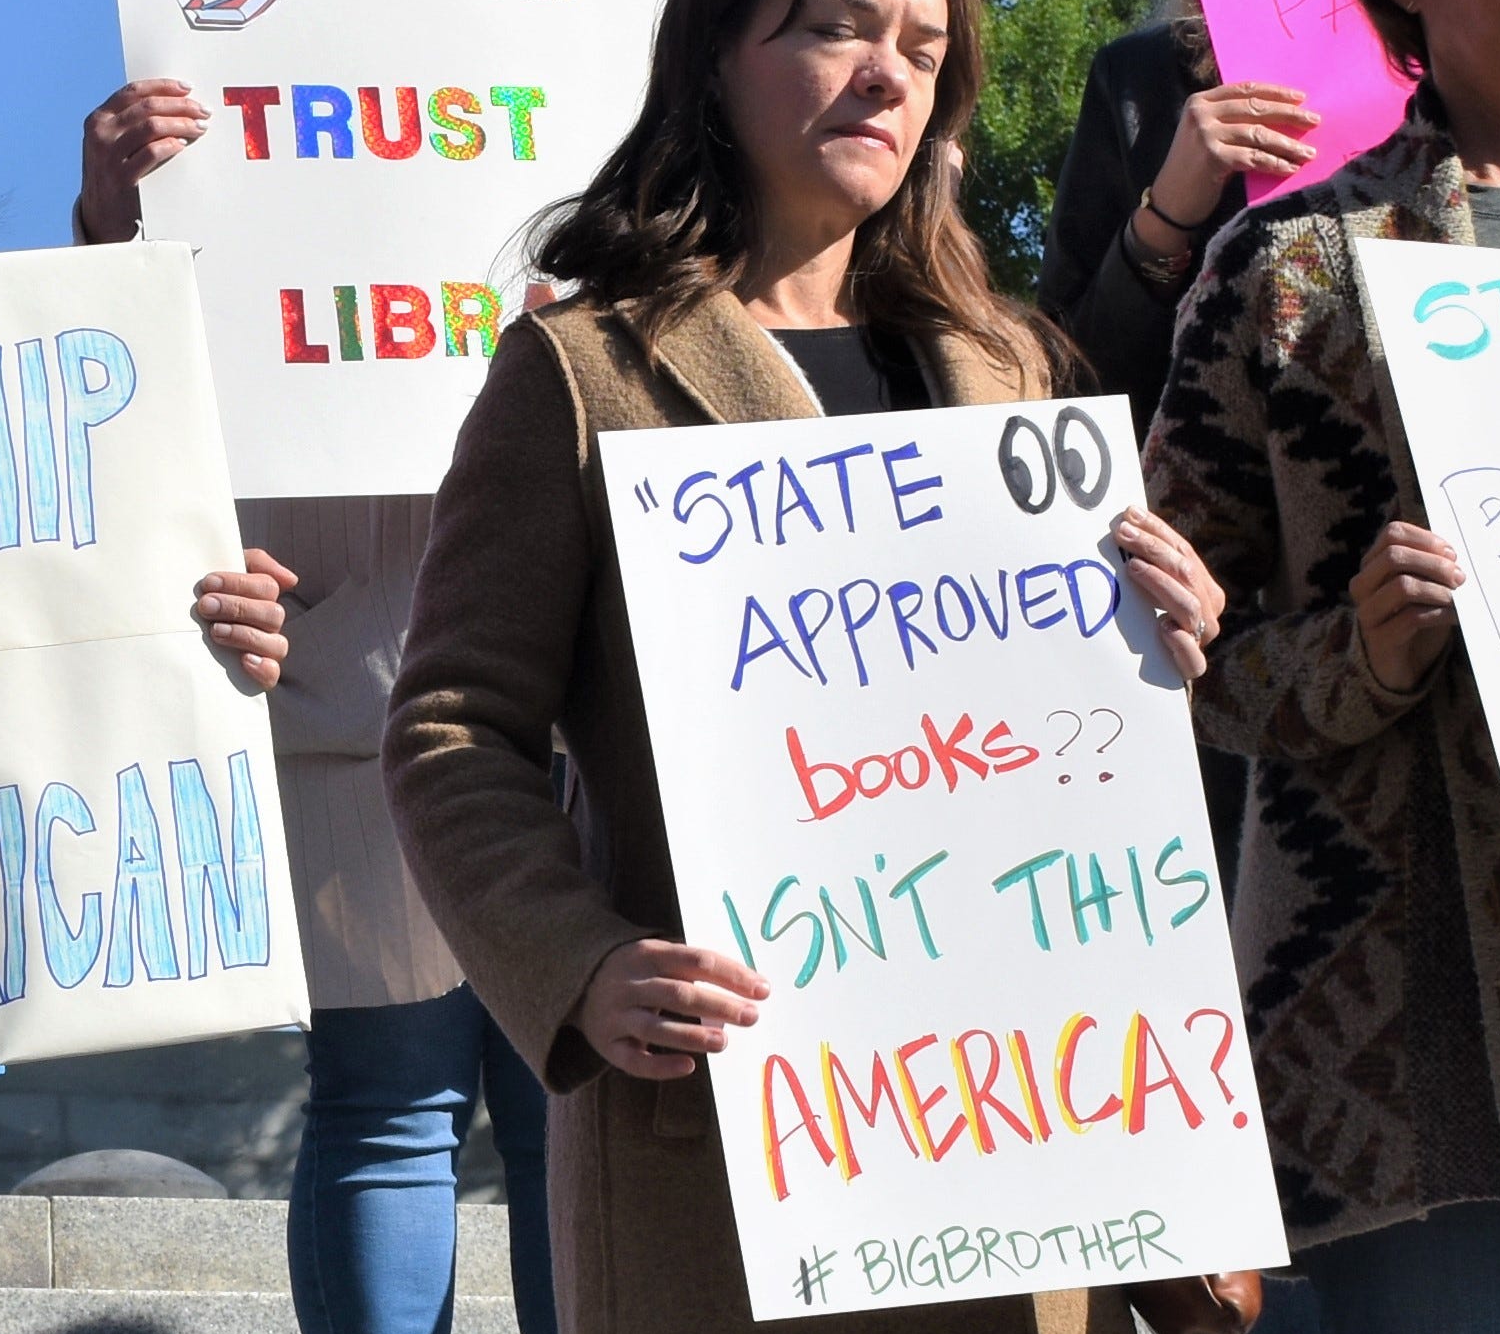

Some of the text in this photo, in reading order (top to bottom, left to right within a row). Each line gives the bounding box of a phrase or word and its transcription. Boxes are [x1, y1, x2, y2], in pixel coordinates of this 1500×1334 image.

[222, 83, 548, 161] TRUST
[721, 835, 1212, 990] ISN'T THIS
[761, 1007, 1250, 1203] AMERICA?
